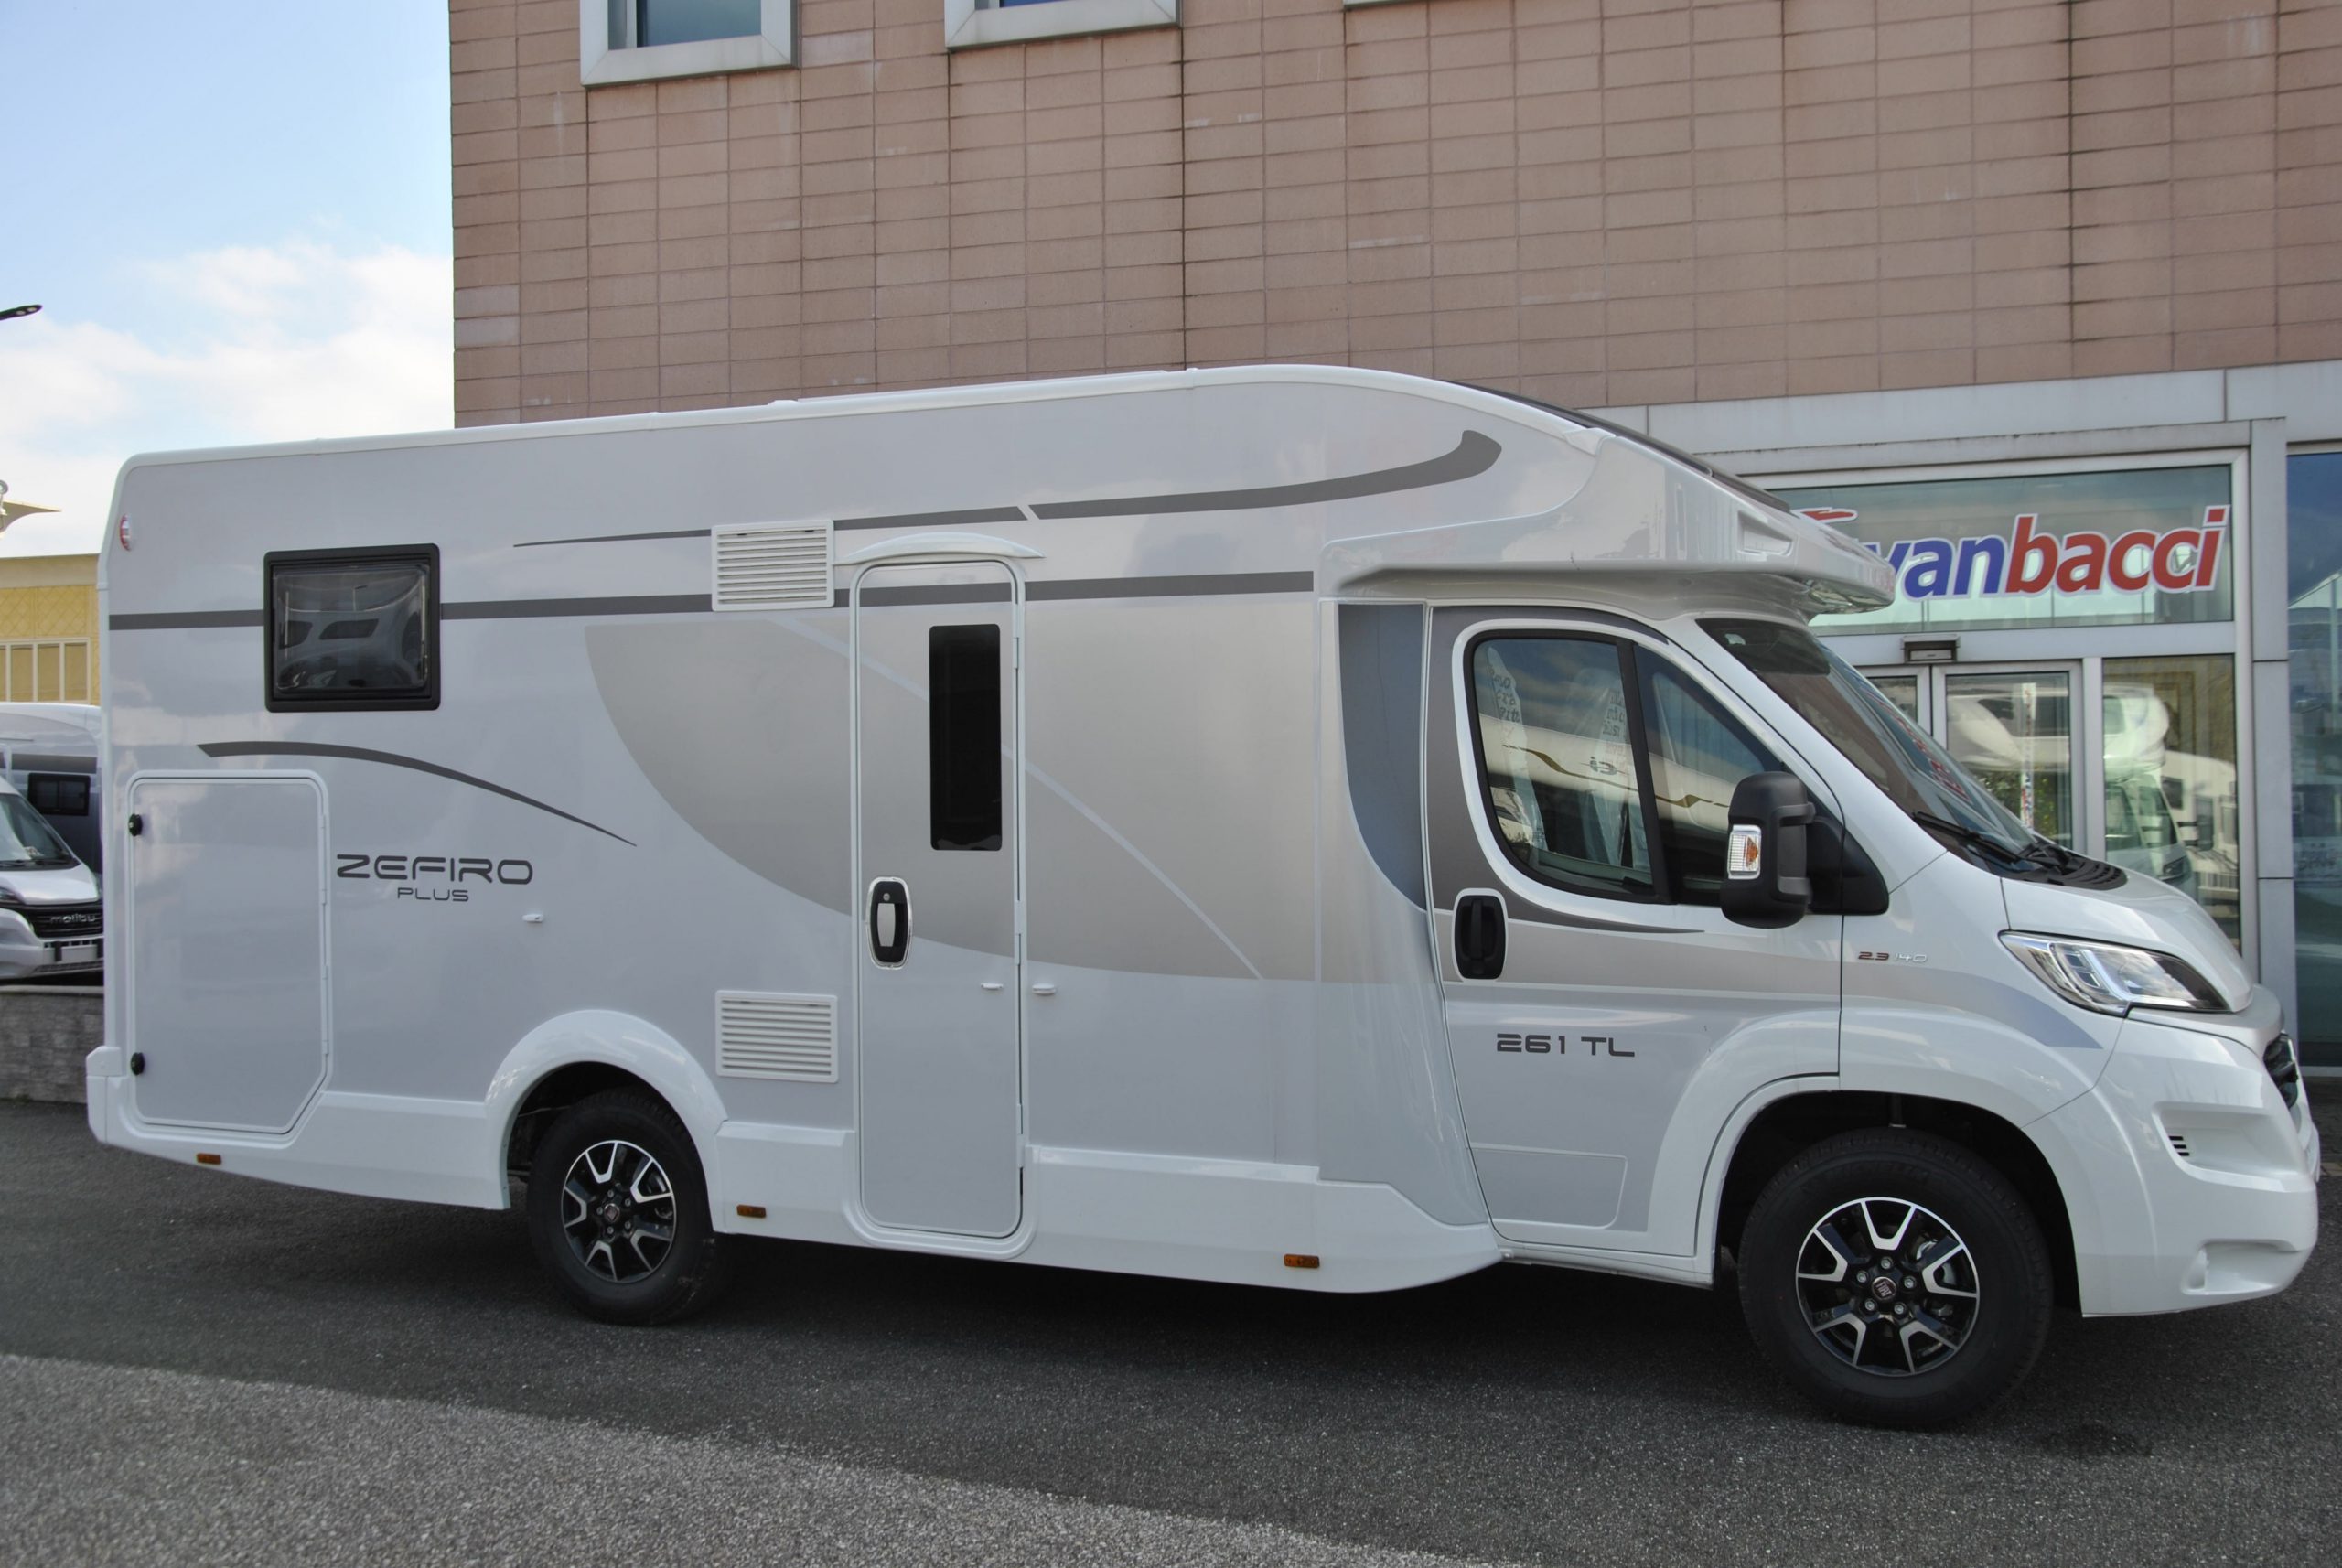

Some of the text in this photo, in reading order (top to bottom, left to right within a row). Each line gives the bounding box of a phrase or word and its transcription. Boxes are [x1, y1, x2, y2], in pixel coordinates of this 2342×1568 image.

[337, 854, 533, 885] ZEFIRO
[397, 887, 469, 902] PLUS
[1497, 1033, 1636, 1058] 261 TL
